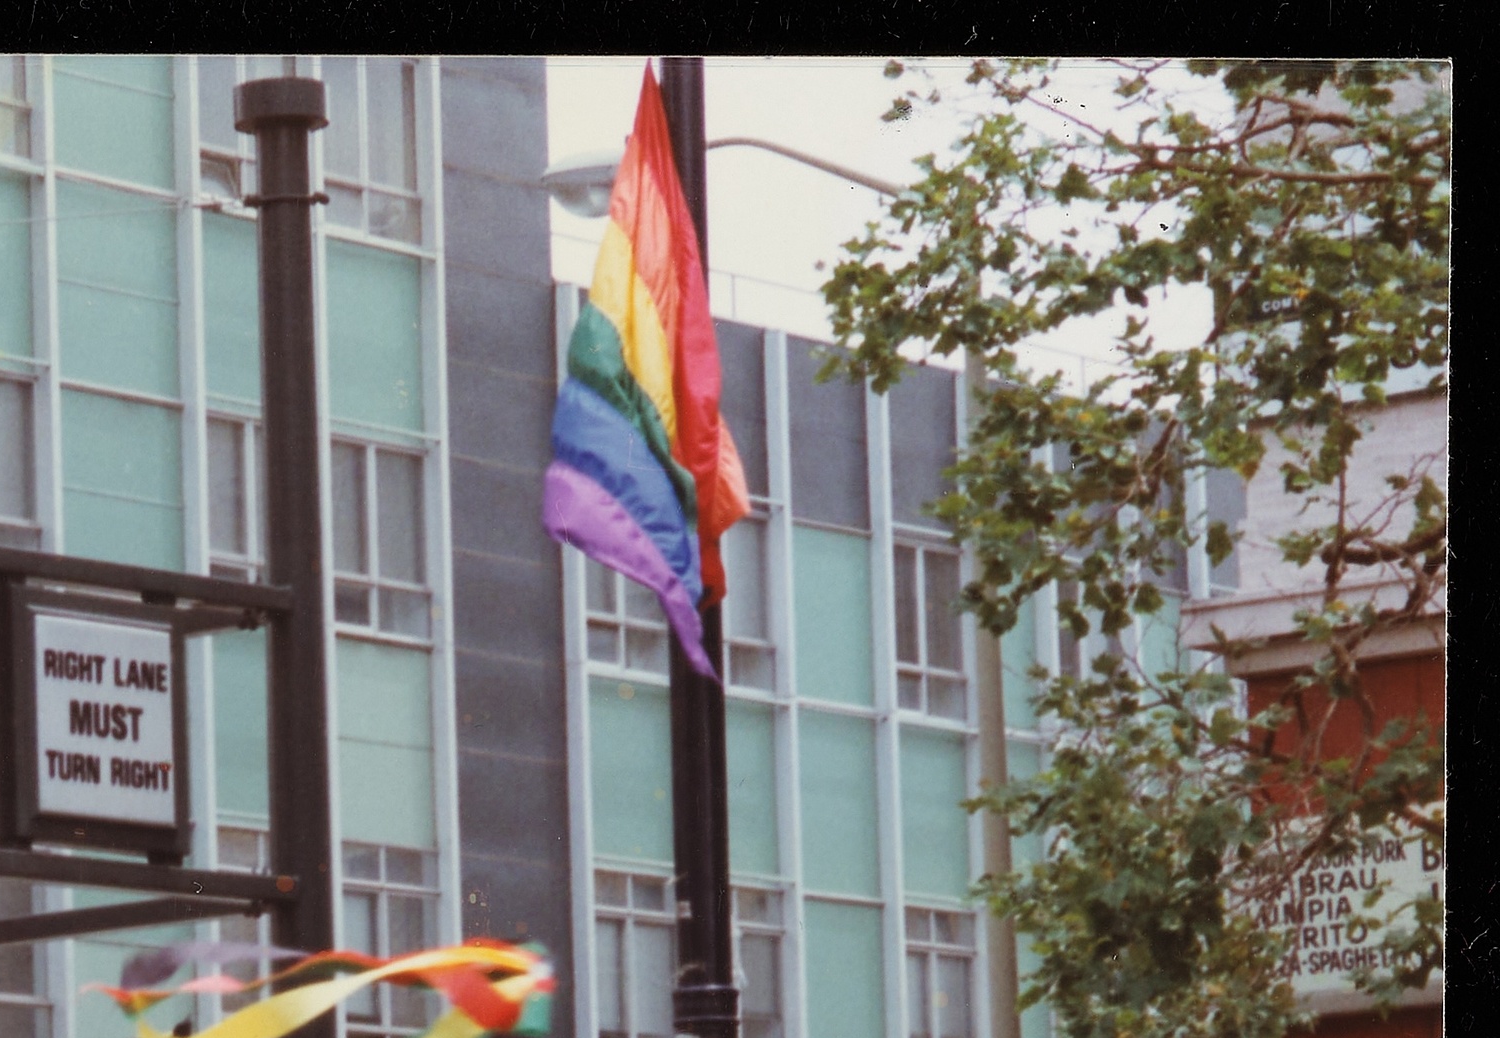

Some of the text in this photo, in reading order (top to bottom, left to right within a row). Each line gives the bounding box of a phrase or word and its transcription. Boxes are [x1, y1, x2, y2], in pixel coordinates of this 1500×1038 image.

[43, 648, 168, 693] RIGHT LANE
[68, 700, 143, 742] MUST
[45, 750, 173, 793] TURN RIGHT
[1299, 867, 1377, 897] BRAU
